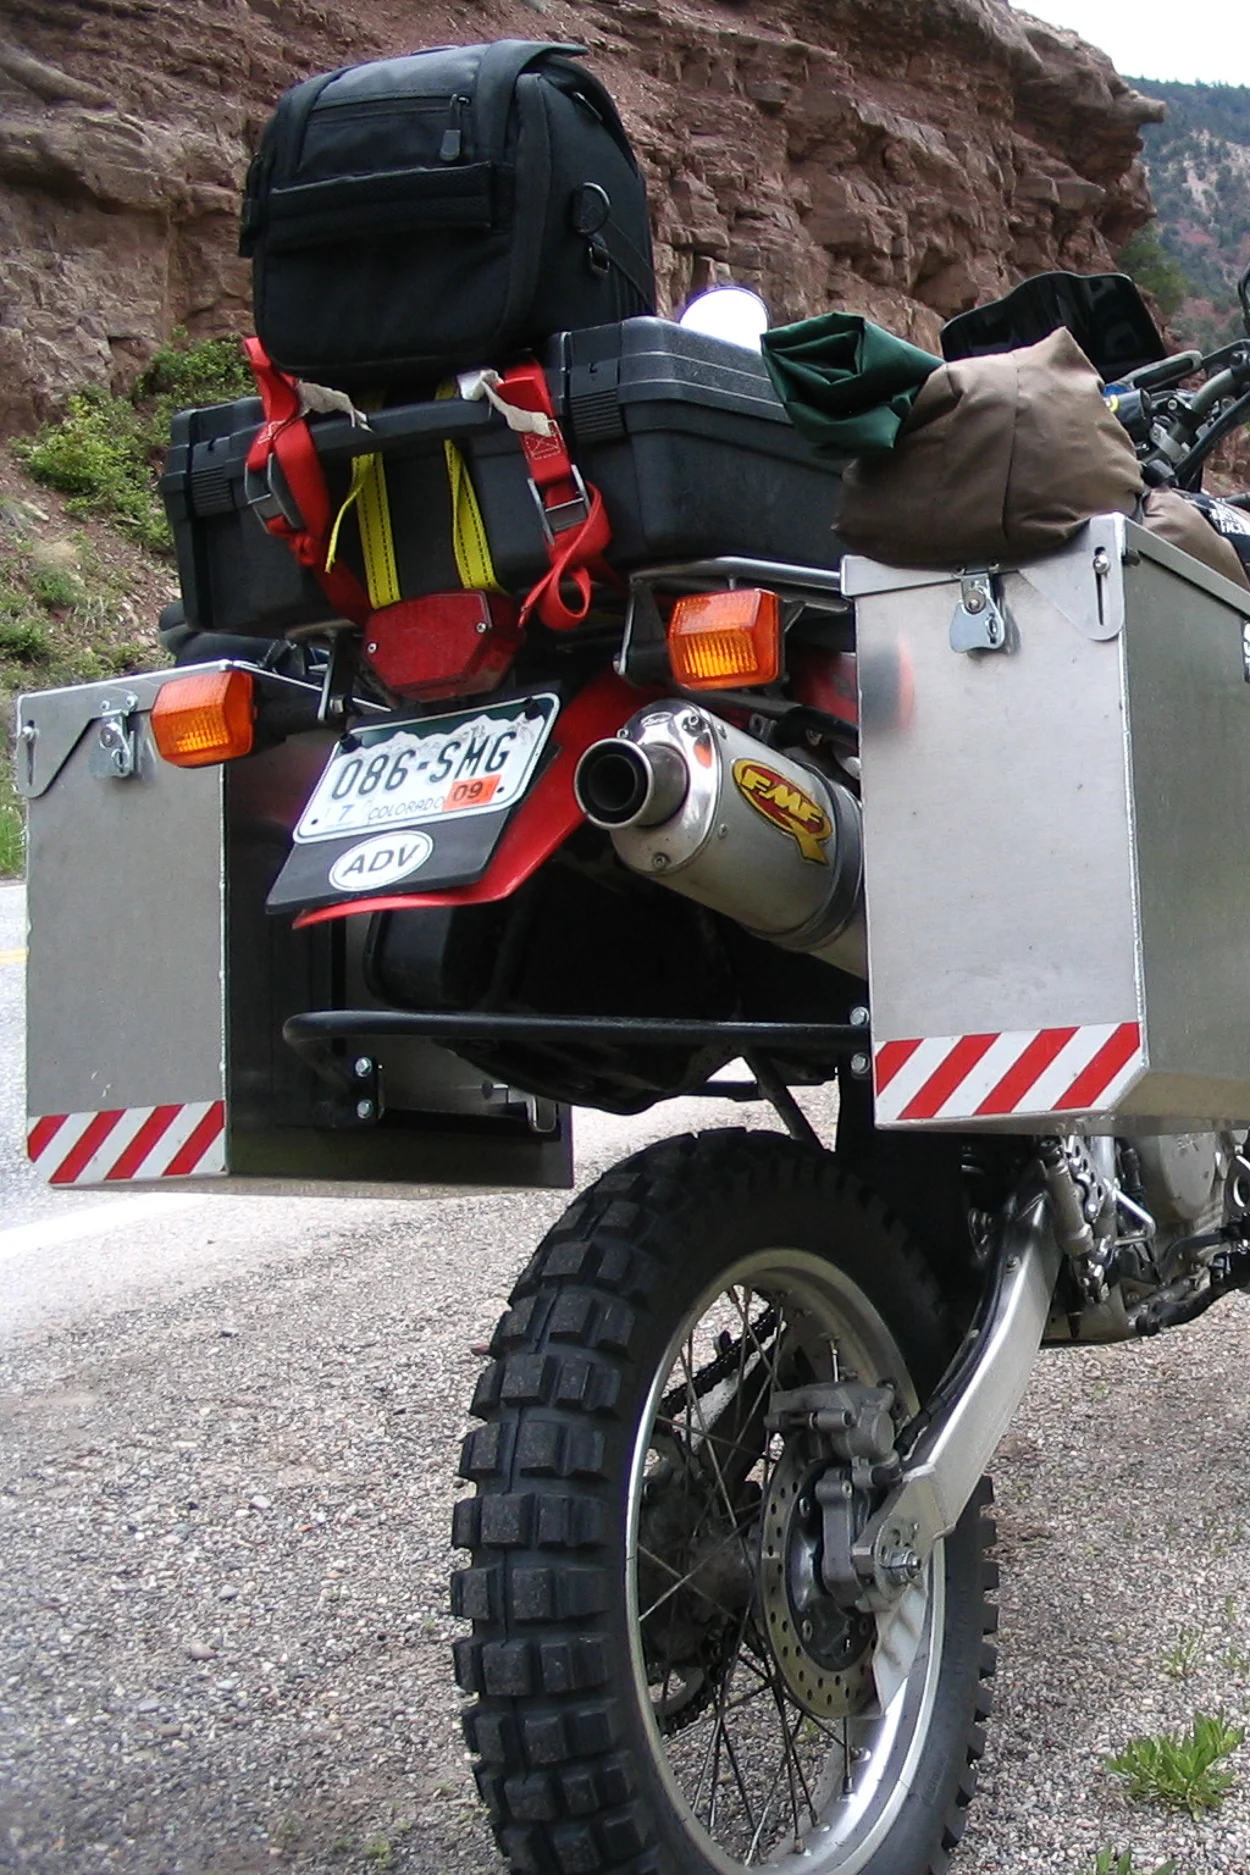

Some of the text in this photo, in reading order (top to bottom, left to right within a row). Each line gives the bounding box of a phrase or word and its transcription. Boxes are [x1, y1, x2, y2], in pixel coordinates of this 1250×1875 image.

[331, 731, 518, 800] 086-SMG
[452, 780, 484, 801] 09
[740, 768, 824, 824] FMF
[367, 795, 446, 823] COLORADO
[341, 843, 422, 878] ADV
